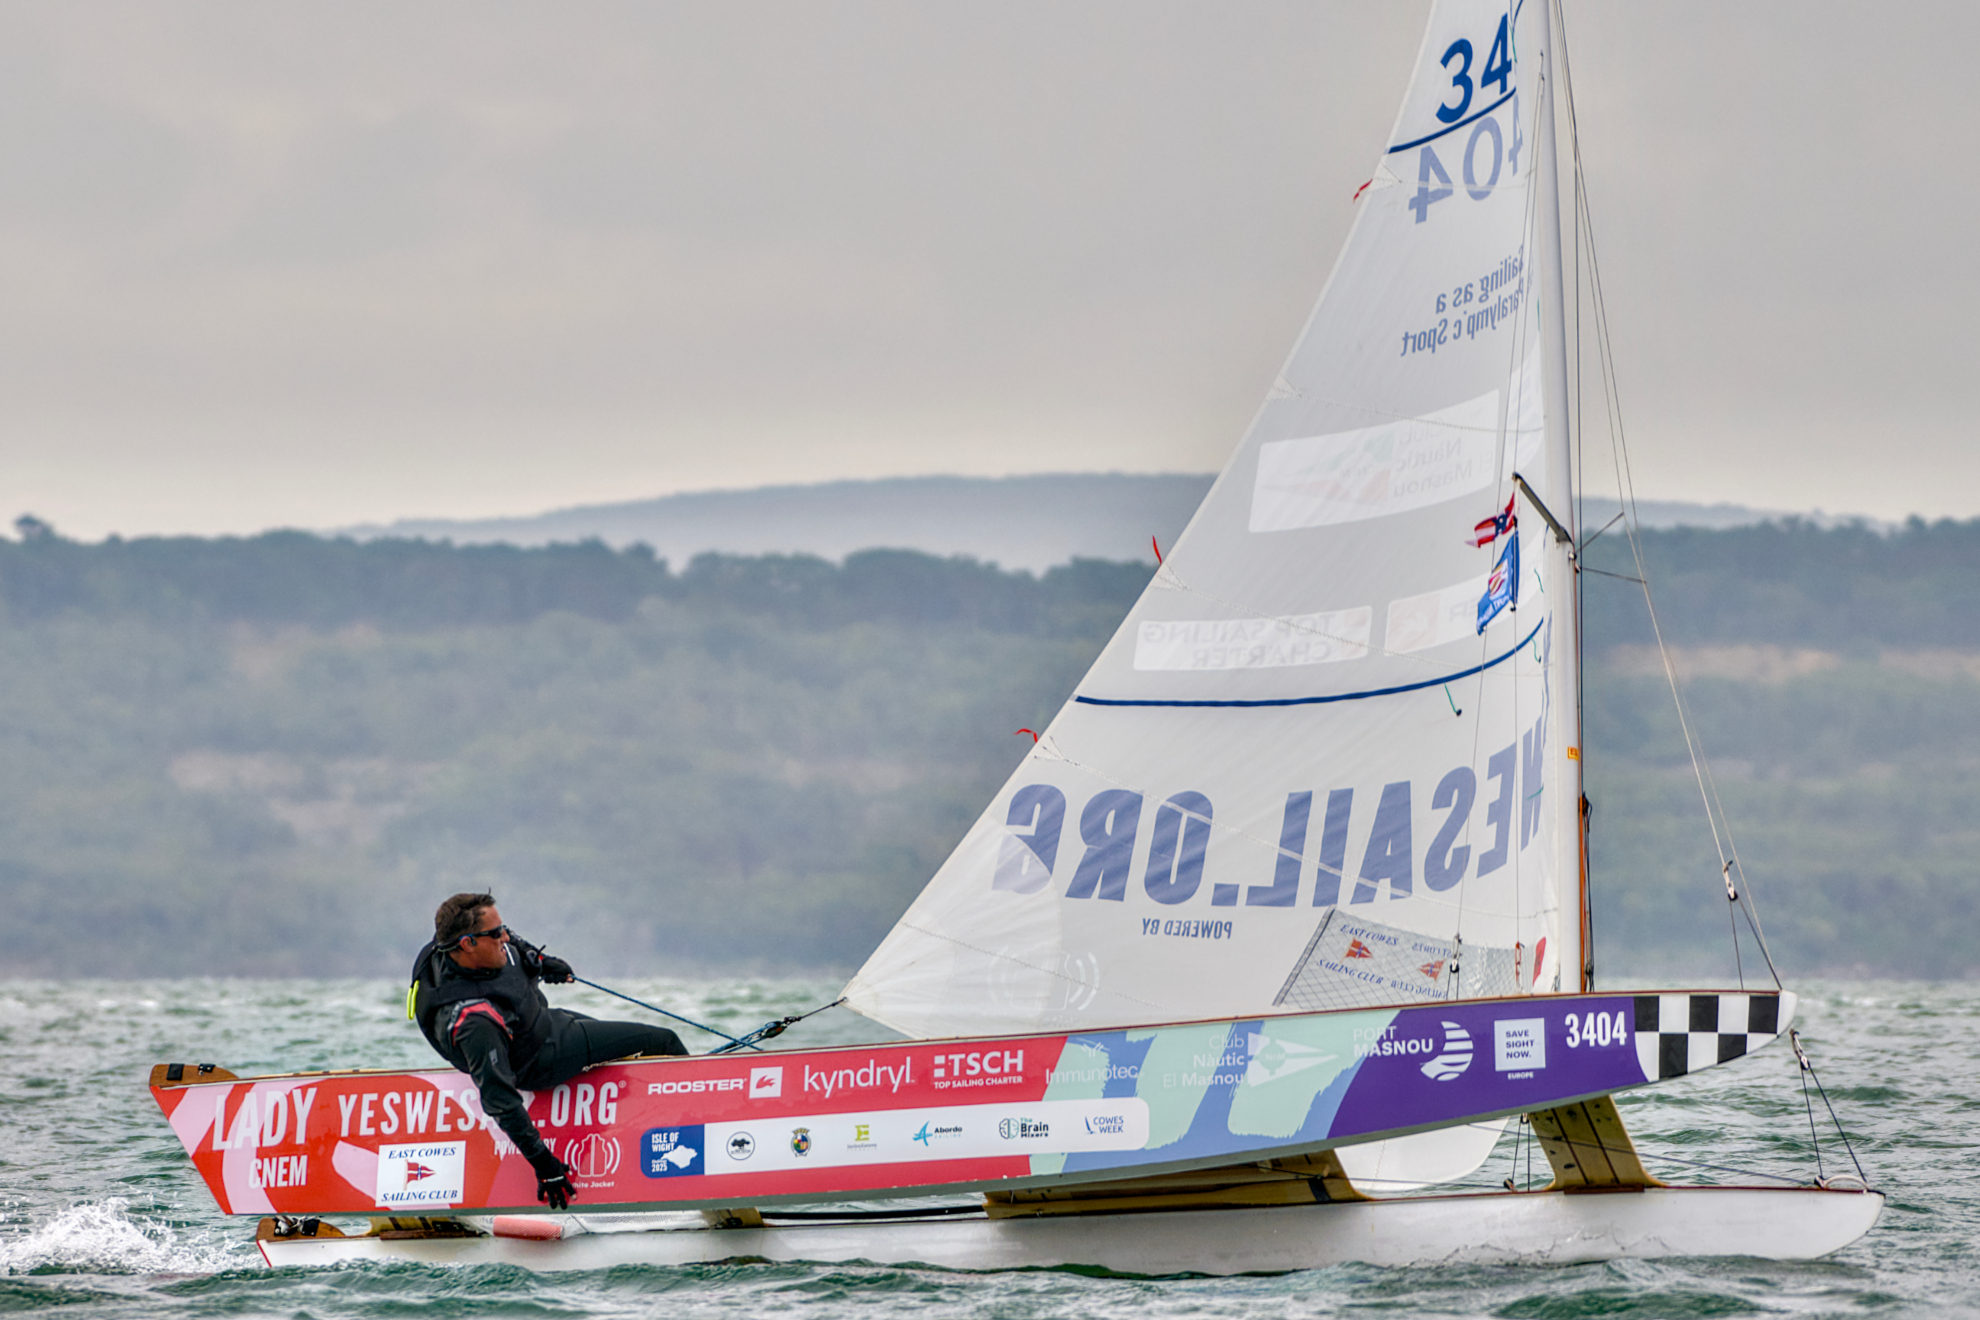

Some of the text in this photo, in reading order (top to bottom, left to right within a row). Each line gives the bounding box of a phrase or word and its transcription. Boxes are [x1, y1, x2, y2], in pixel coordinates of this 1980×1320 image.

[1340, 924, 1366, 937] EAST
[1316, 958, 1384, 984] SAILING CLUB
[1353, 1025, 1397, 1042] PORT
[1505, 1029, 1530, 1038] SAVE
[1565, 1011, 1627, 1049] 3404
[1209, 1033, 1245, 1049] Club
[1506, 1039, 1535, 1049] SIGHT
[1353, 1038, 1434, 1058] MASNOU
[1193, 1052, 1245, 1068] Nàutic
[1506, 1050, 1532, 1060] NOW.
[948, 1050, 1024, 1077] TSCH
[804, 1056, 912, 1099] kyndryl
[1046, 1064, 1139, 1084] Immunotec
[1163, 1072, 1244, 1088] El Masnou
[1507, 1071, 1534, 1080] EUROPE
[648, 1077, 744, 1095] ROOSTER
[934, 1076, 1023, 1090] TOP SAILING CHARTER
[212, 1087, 317, 1151] LADY
[1093, 1115, 1124, 1125] COWES
[934, 1125, 963, 1134] Abordo
[1020, 1121, 1049, 1133] Brain
[1099, 1124, 1124, 1134] WEEK
[652, 1132, 679, 1143] ISLE OF
[388, 1147, 456, 1159] EAST COWES
[652, 1143, 675, 1152] WIGHT
[248, 1154, 308, 1189] CNEM
[652, 1163, 668, 1172] 2025
[590, 1180, 615, 1188] Jacket
[381, 1189, 458, 1202] SAILING CLUB
